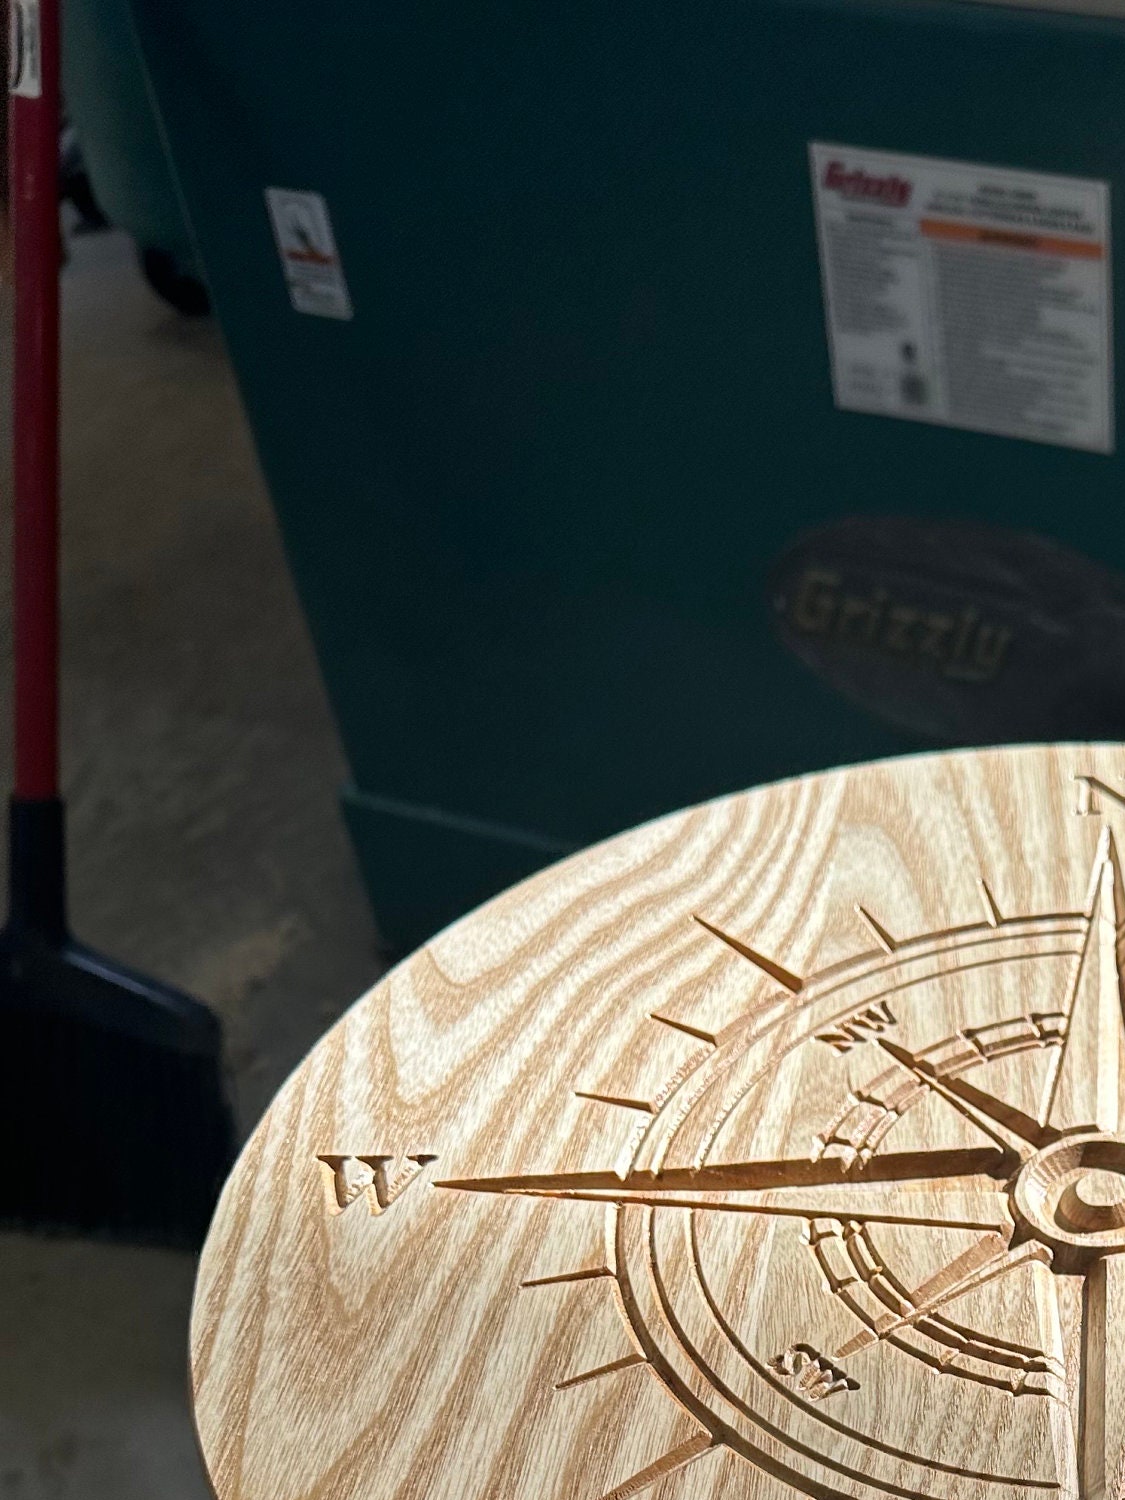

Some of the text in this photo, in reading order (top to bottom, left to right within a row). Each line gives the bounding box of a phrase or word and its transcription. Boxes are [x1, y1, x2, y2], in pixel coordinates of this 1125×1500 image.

[793, 567, 1013, 684] Grizzly
[811, 1000, 898, 1057] NW
[315, 1153, 439, 1217] W
[766, 1343, 860, 1401] SW
